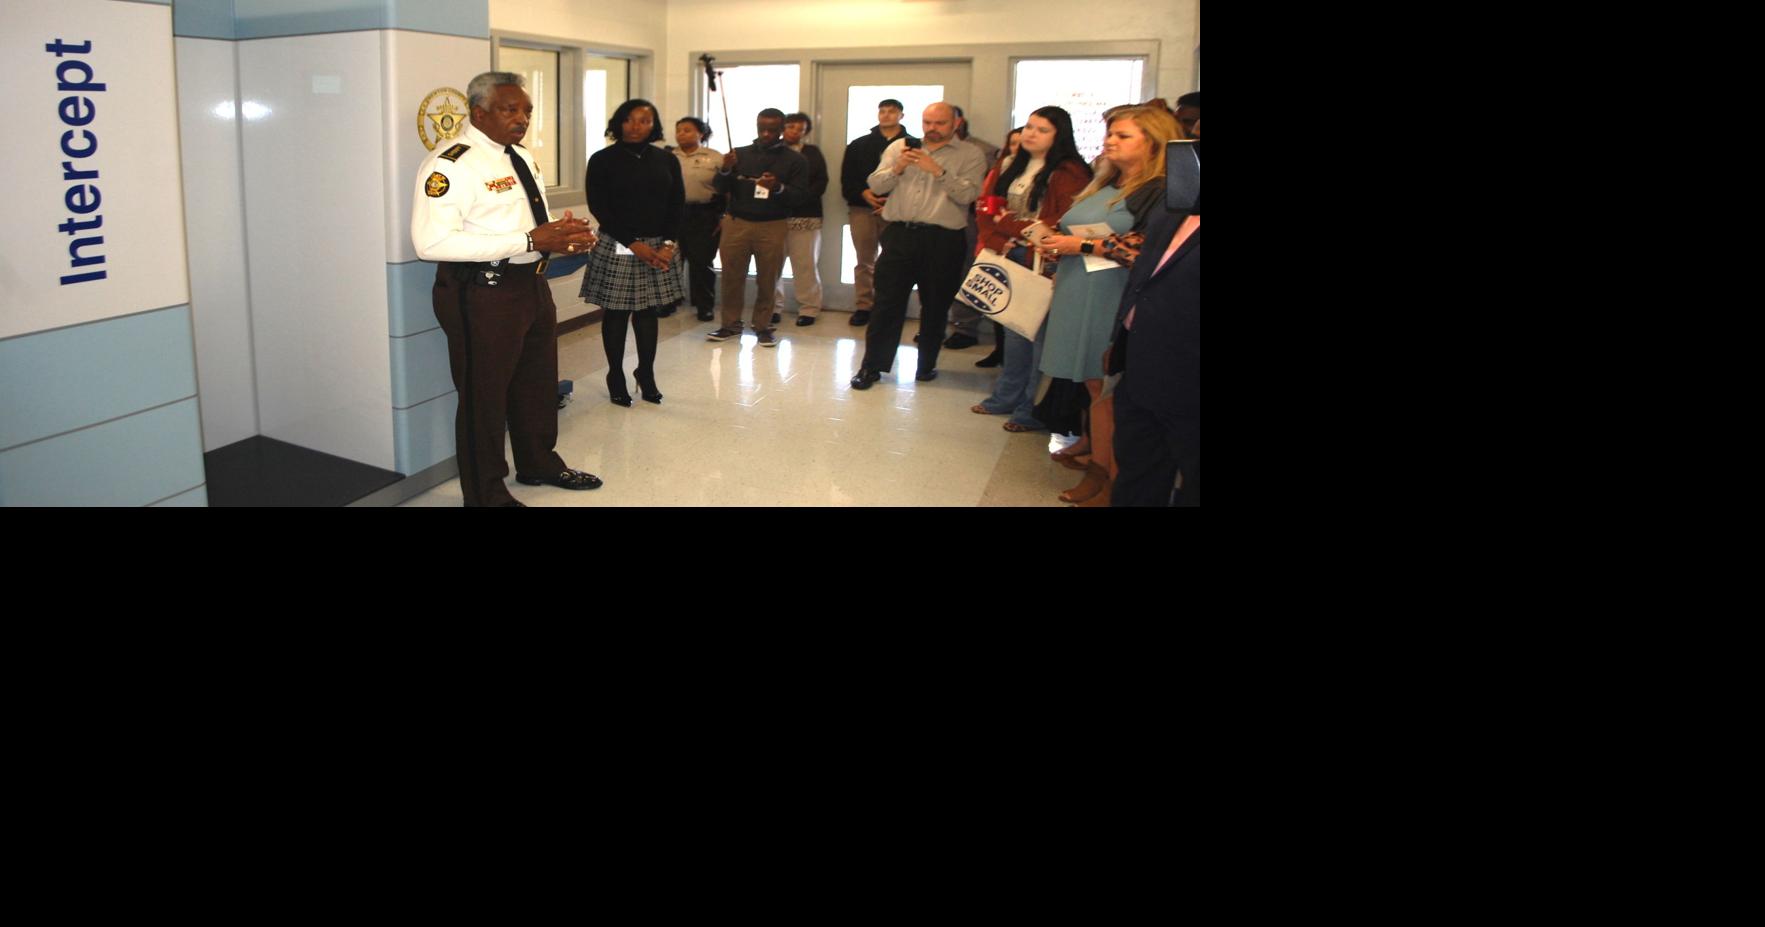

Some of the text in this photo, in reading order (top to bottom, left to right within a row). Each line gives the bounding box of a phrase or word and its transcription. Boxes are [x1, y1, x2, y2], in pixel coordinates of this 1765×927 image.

[45, 38, 107, 286] Intercept
[965, 279, 997, 306] SMALL
[975, 274, 1003, 295] SHOP
